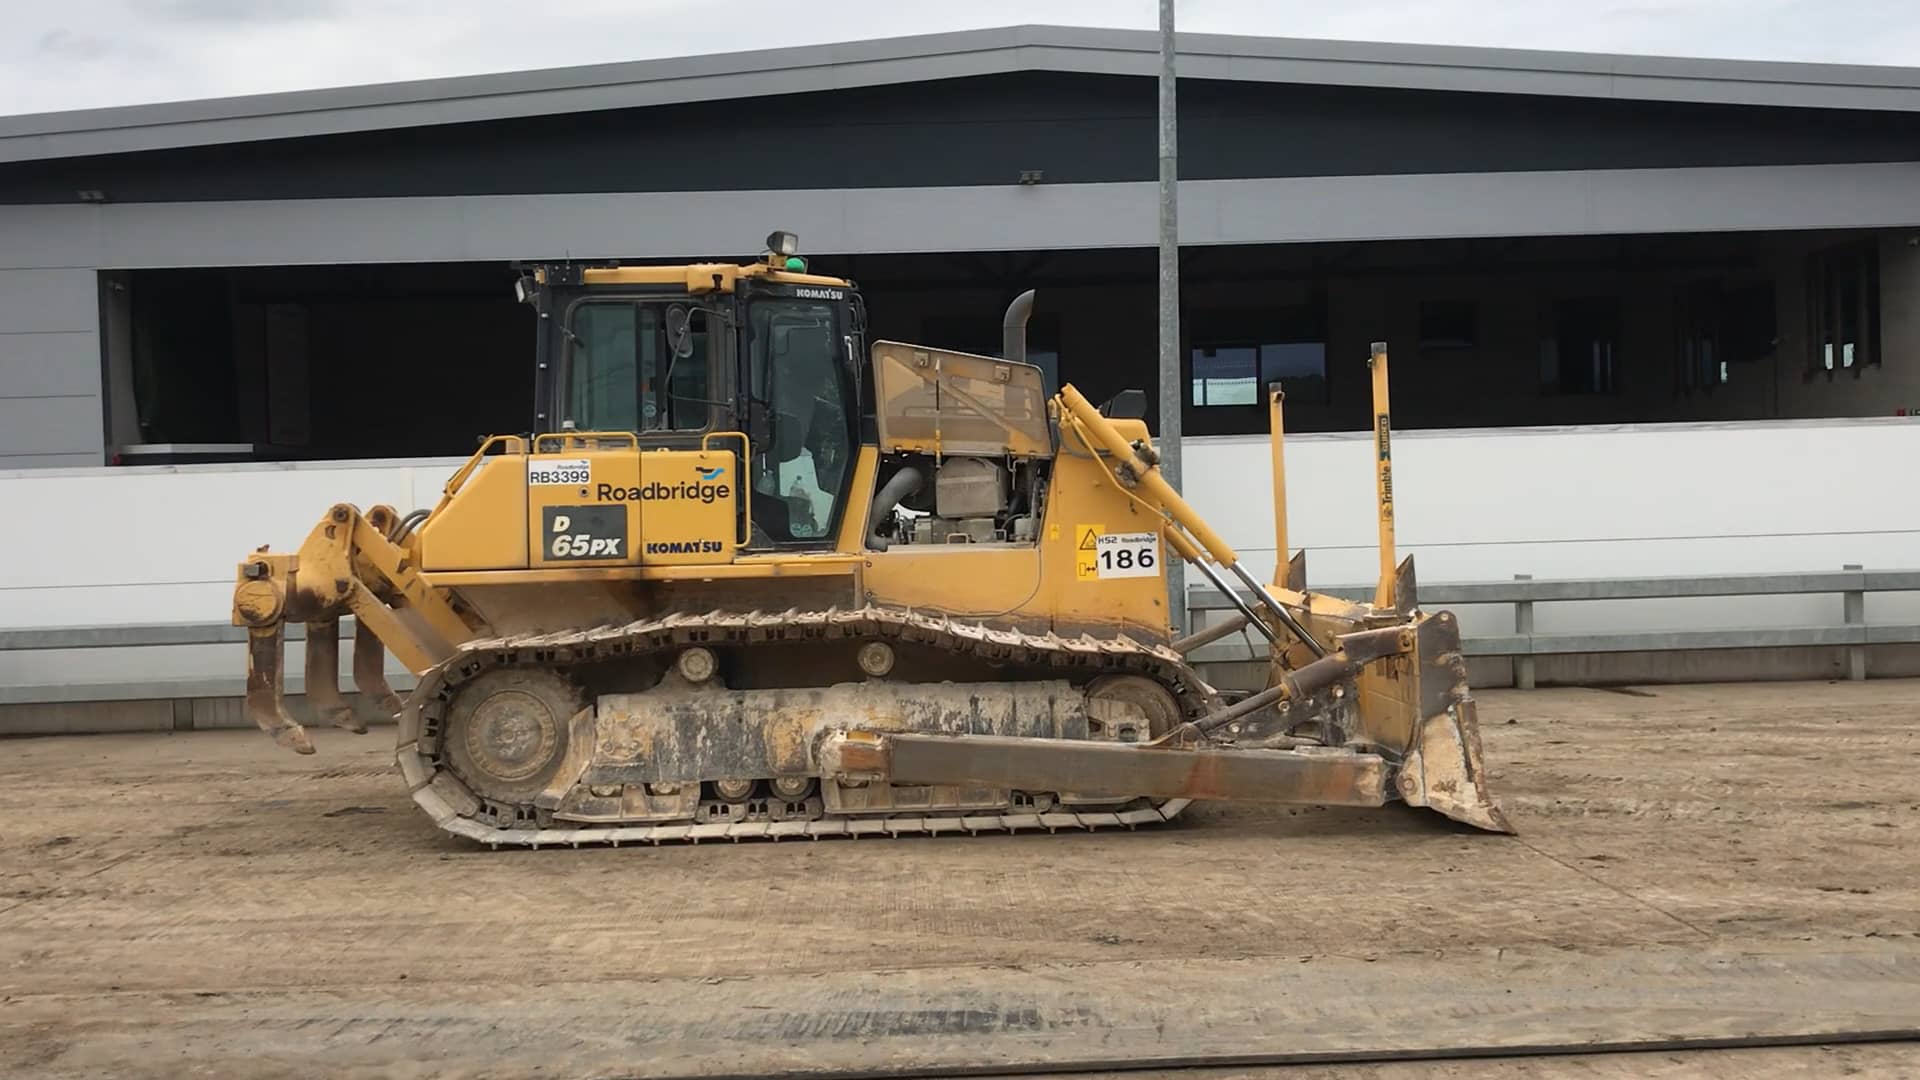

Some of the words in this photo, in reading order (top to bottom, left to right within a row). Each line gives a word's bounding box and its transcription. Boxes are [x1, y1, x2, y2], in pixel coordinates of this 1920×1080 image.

[796, 288, 843, 300] KOMATSU
[530, 471, 590, 483] RB3399
[1382, 466, 1392, 504] Trimble
[598, 481, 730, 504] Roadbridge
[553, 516, 570, 532] D
[552, 534, 621, 557] 65PX
[647, 540, 722, 554] KOMATSU
[1101, 548, 1154, 570] 186
